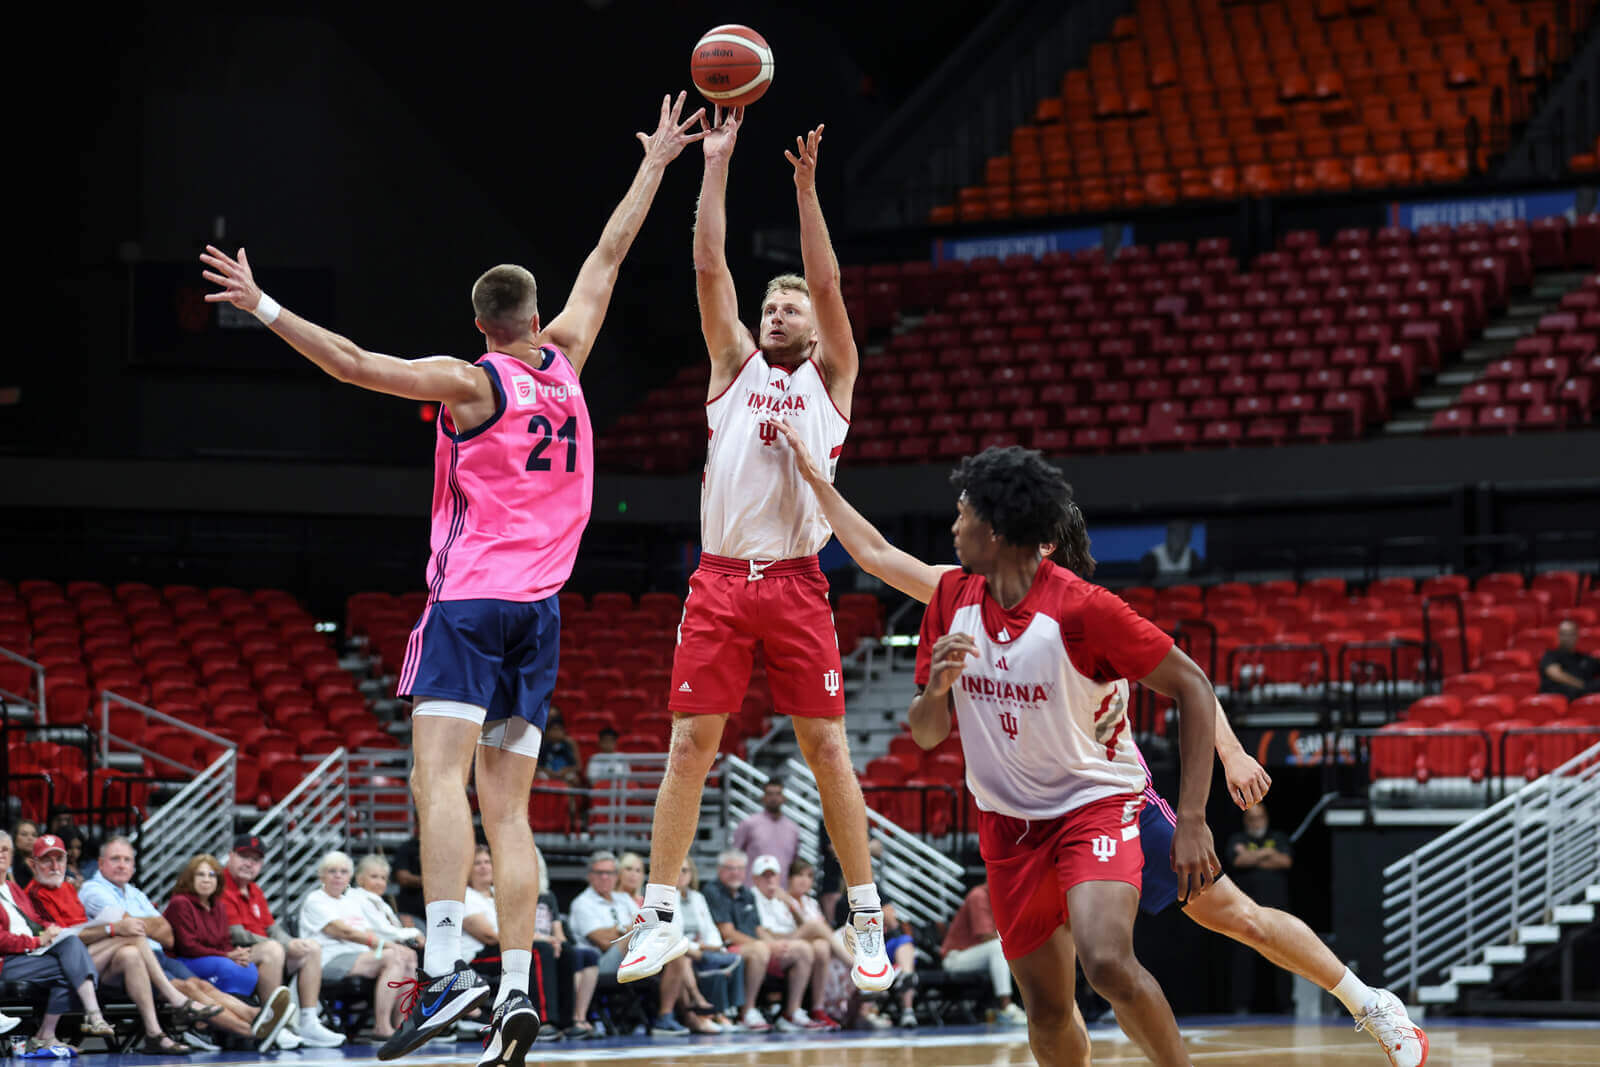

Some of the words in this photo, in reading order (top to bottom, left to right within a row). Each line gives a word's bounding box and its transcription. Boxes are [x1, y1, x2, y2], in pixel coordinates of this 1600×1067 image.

[747, 393, 806, 412] INDIANA
[525, 415, 577, 472] 21
[961, 674, 1048, 702] INDIANA
